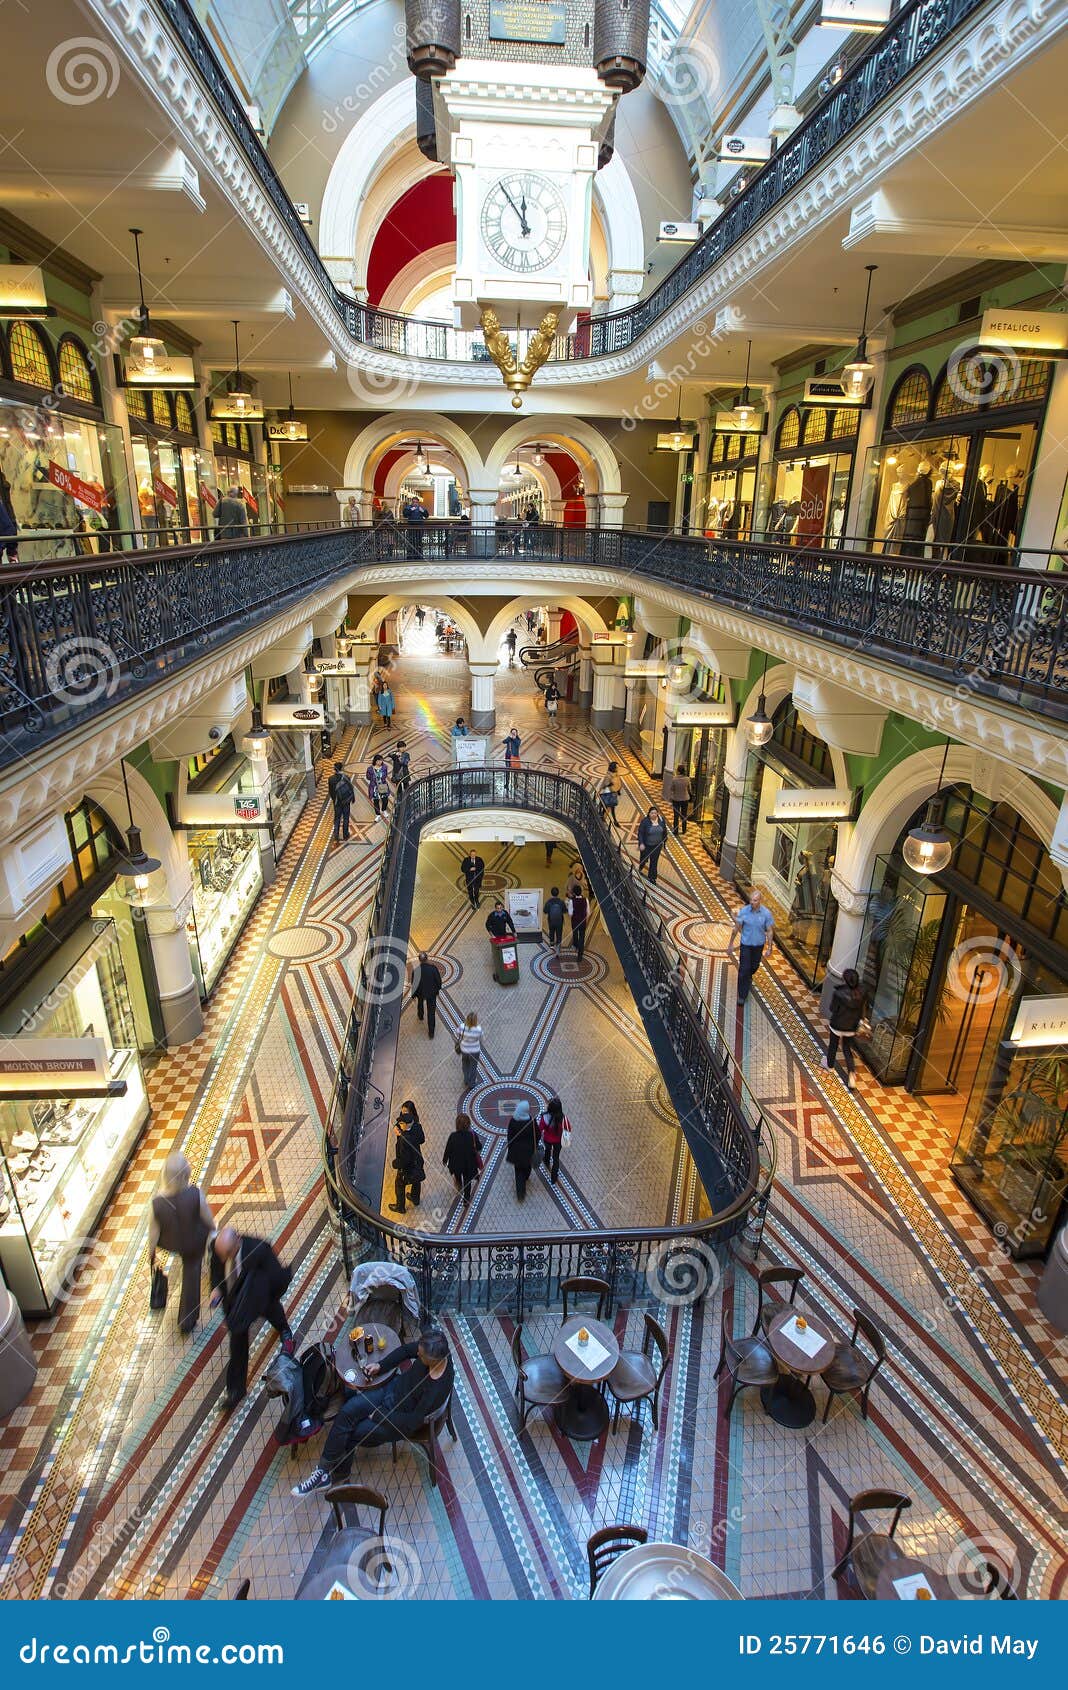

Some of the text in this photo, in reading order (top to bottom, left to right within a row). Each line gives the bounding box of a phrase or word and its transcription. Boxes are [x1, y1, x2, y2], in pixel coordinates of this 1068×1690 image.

[990, 322, 1041, 333] METALICUS
[54, 468, 72, 491] 50%
[800, 493, 824, 520] sale
[238, 800, 256, 809] TAG
[814, 800, 847, 808] LAUREN
[236, 809, 259, 819] HEUER
[3, 1061, 84, 1072] MOLTON BROWN
